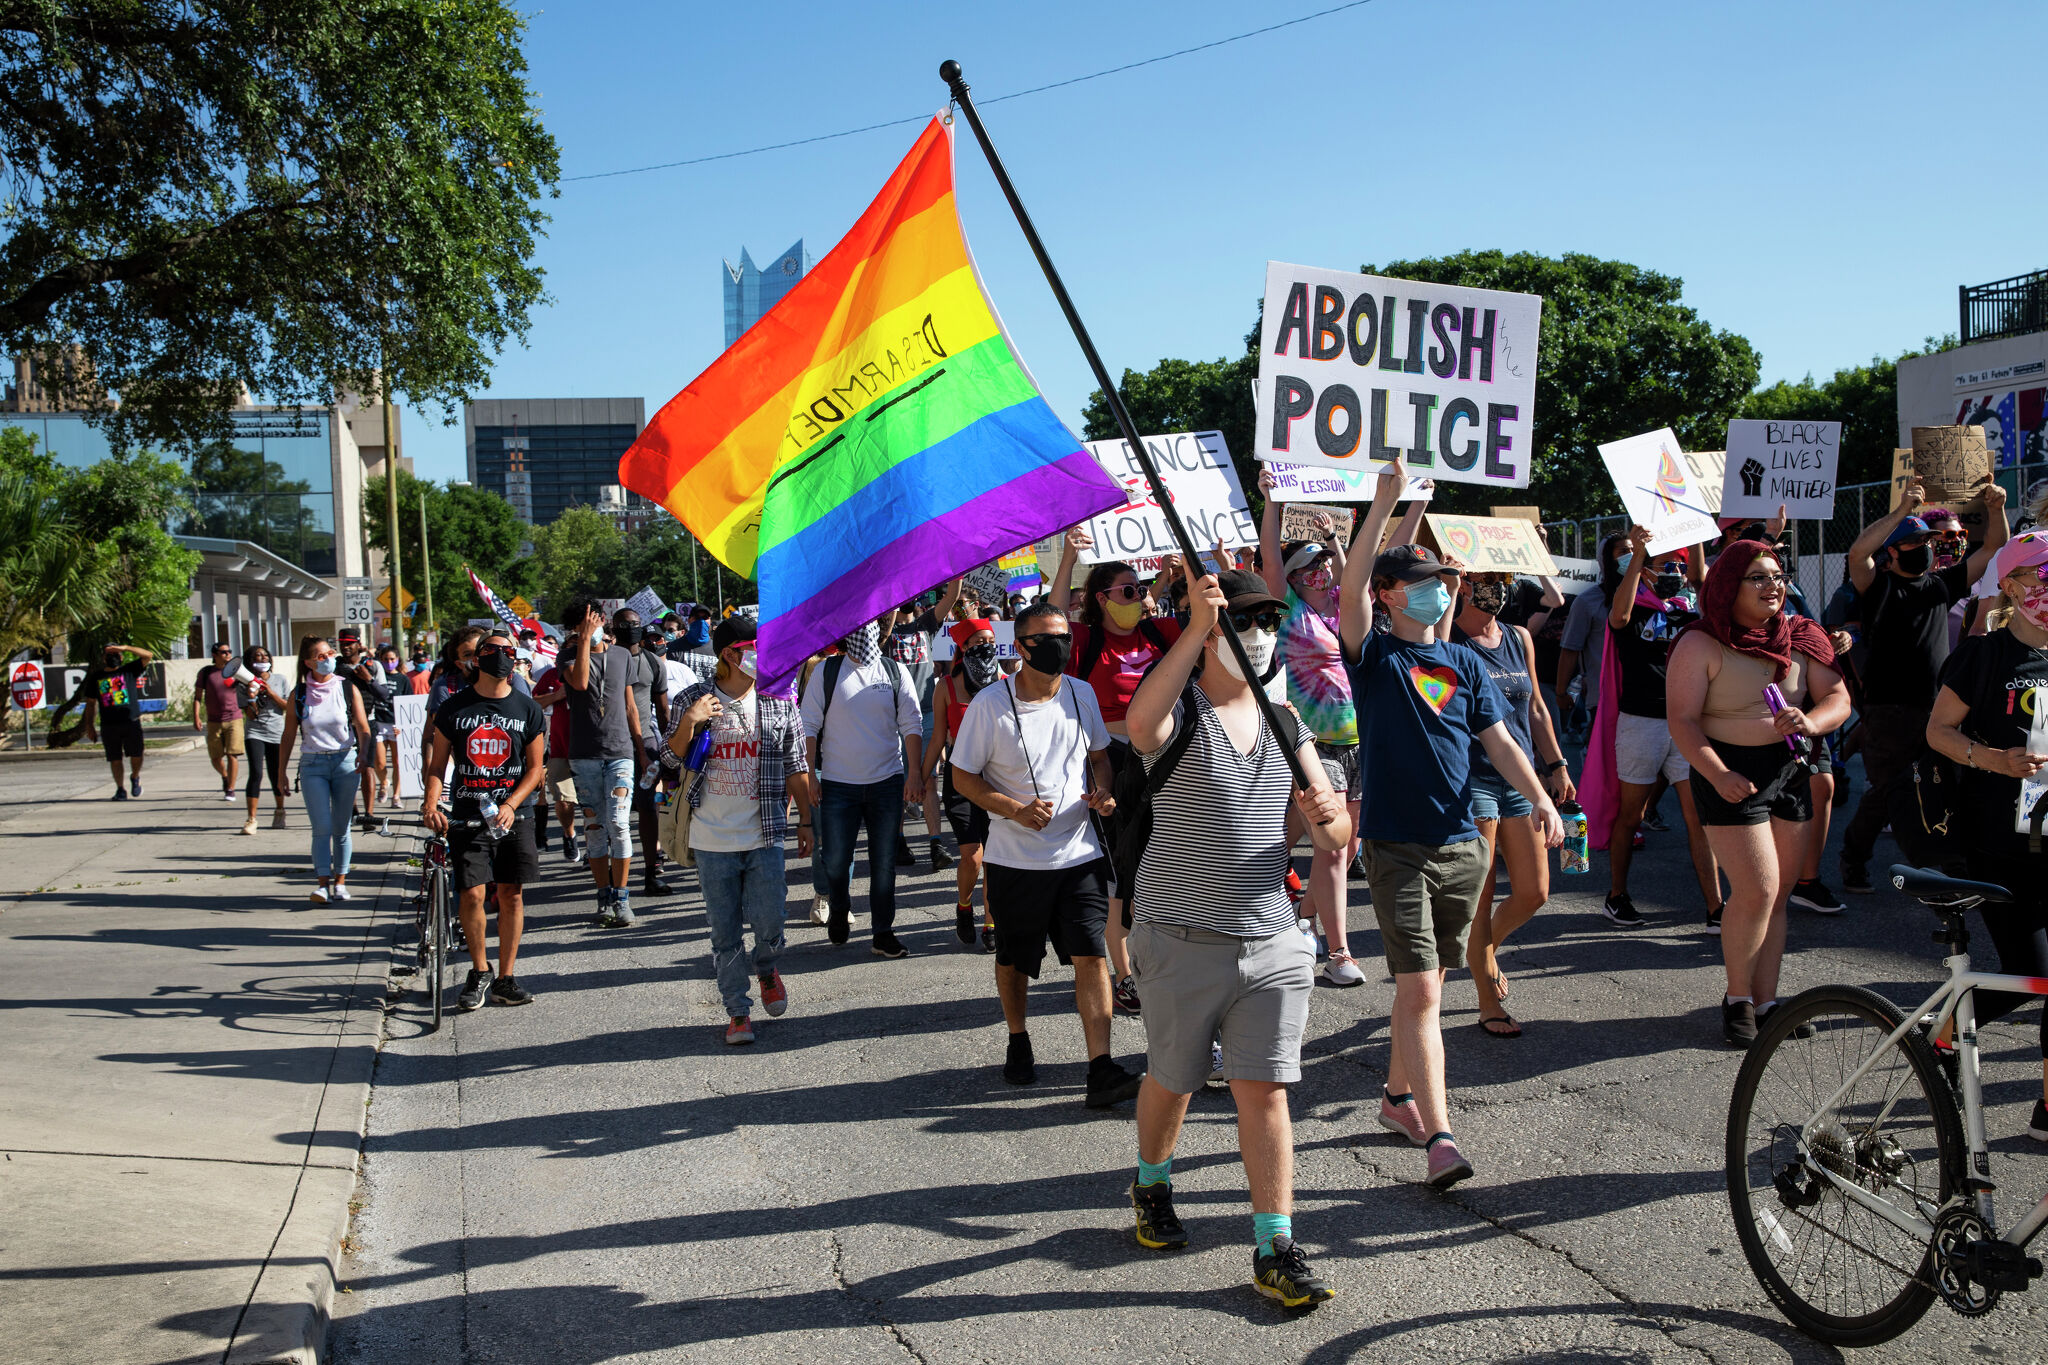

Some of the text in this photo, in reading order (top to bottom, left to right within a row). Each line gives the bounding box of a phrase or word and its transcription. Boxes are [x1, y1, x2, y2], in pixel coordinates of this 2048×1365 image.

[1273, 281, 1499, 384] ABOLISH
[1271, 375, 1520, 480] POLICE
[1765, 422, 1833, 446] BLACK
[1092, 432, 1229, 478] LENCE
[1771, 449, 1823, 470] LIVES
[1272, 474, 1298, 488] THIS
[1301, 480, 1346, 494] LESSON
[1770, 476, 1833, 500] MATTER
[1283, 525, 1305, 540] SAY
[1477, 525, 1517, 541] PRIDE
[1485, 543, 1537, 567] BLM!
[1122, 556, 1163, 572] ETRAY
[980, 565, 1006, 582] THE
[1572, 568, 1597, 583] WOMEN
[962, 573, 1007, 597] ANGE YOU
[986, 592, 1000, 603] SEE
[348, 608, 369, 620] 30
[15, 670, 39, 680] DO NOT
[2005, 677, 2048, 690] above
[18, 692, 38, 700] ENTER
[399, 702, 423, 725] NO
[455, 717, 460, 730] I
[401, 727, 423, 749] NO
[470, 738, 508, 755] STOP
[404, 752, 423, 773] NO
[492, 766, 505, 776] US
